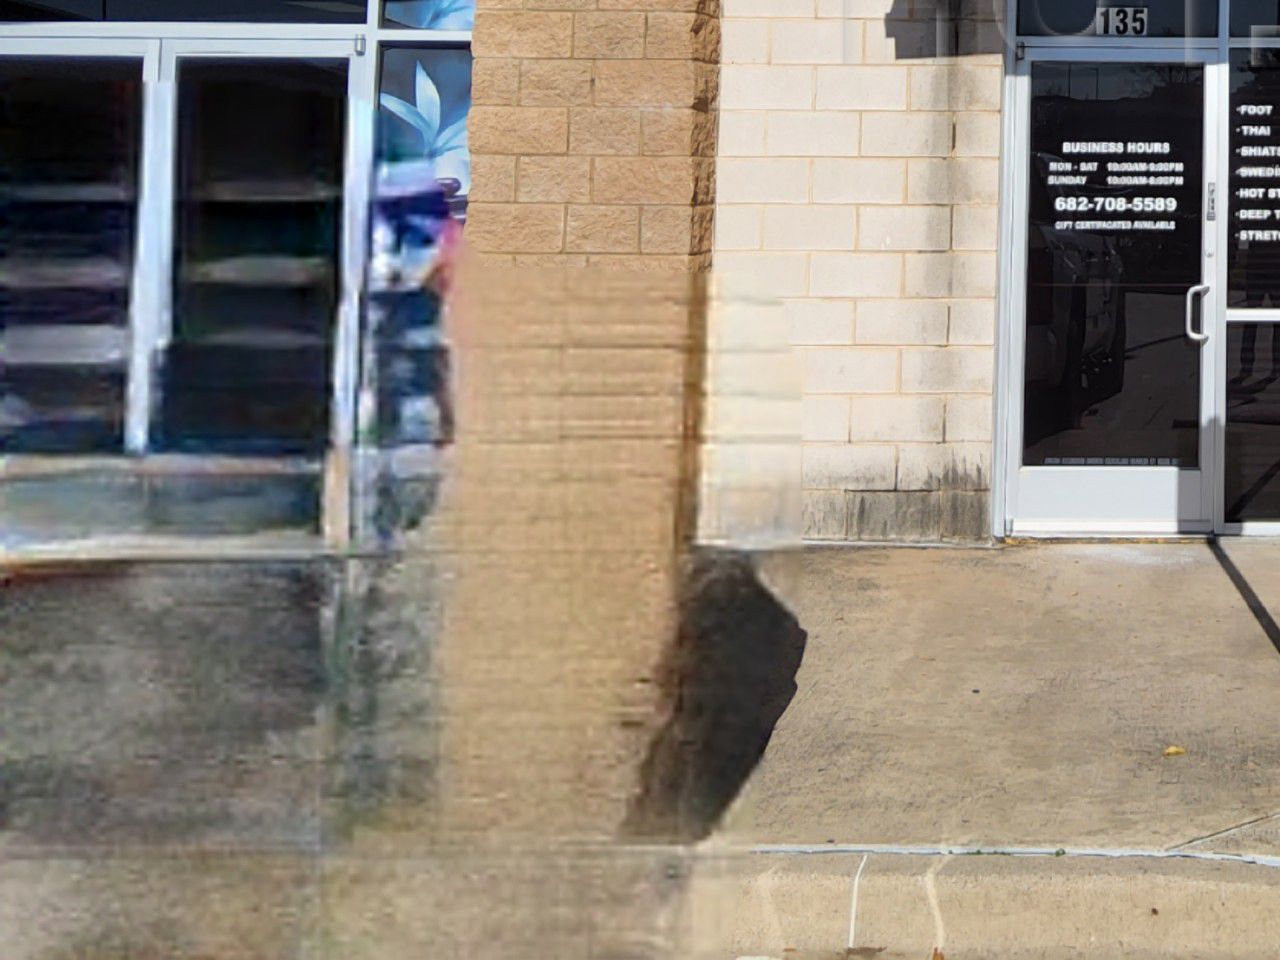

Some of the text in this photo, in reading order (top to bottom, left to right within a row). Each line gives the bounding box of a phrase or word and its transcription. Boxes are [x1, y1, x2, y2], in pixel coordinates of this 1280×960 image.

[1100, 8, 1145, 35] 135
[1240, 105, 1273, 116] FOOT
[1241, 125, 1271, 136] THAI
[1062, 142, 1170, 153] BUSINESS HOURS
[1049, 162, 1072, 171] MON
[1079, 162, 1099, 171] SAT
[1047, 175, 1087, 185] SUNDAY
[1240, 187, 1265, 199] HOT
[1055, 196, 1177, 212] 682-708-5589
[1240, 209, 1271, 220] DEEP
